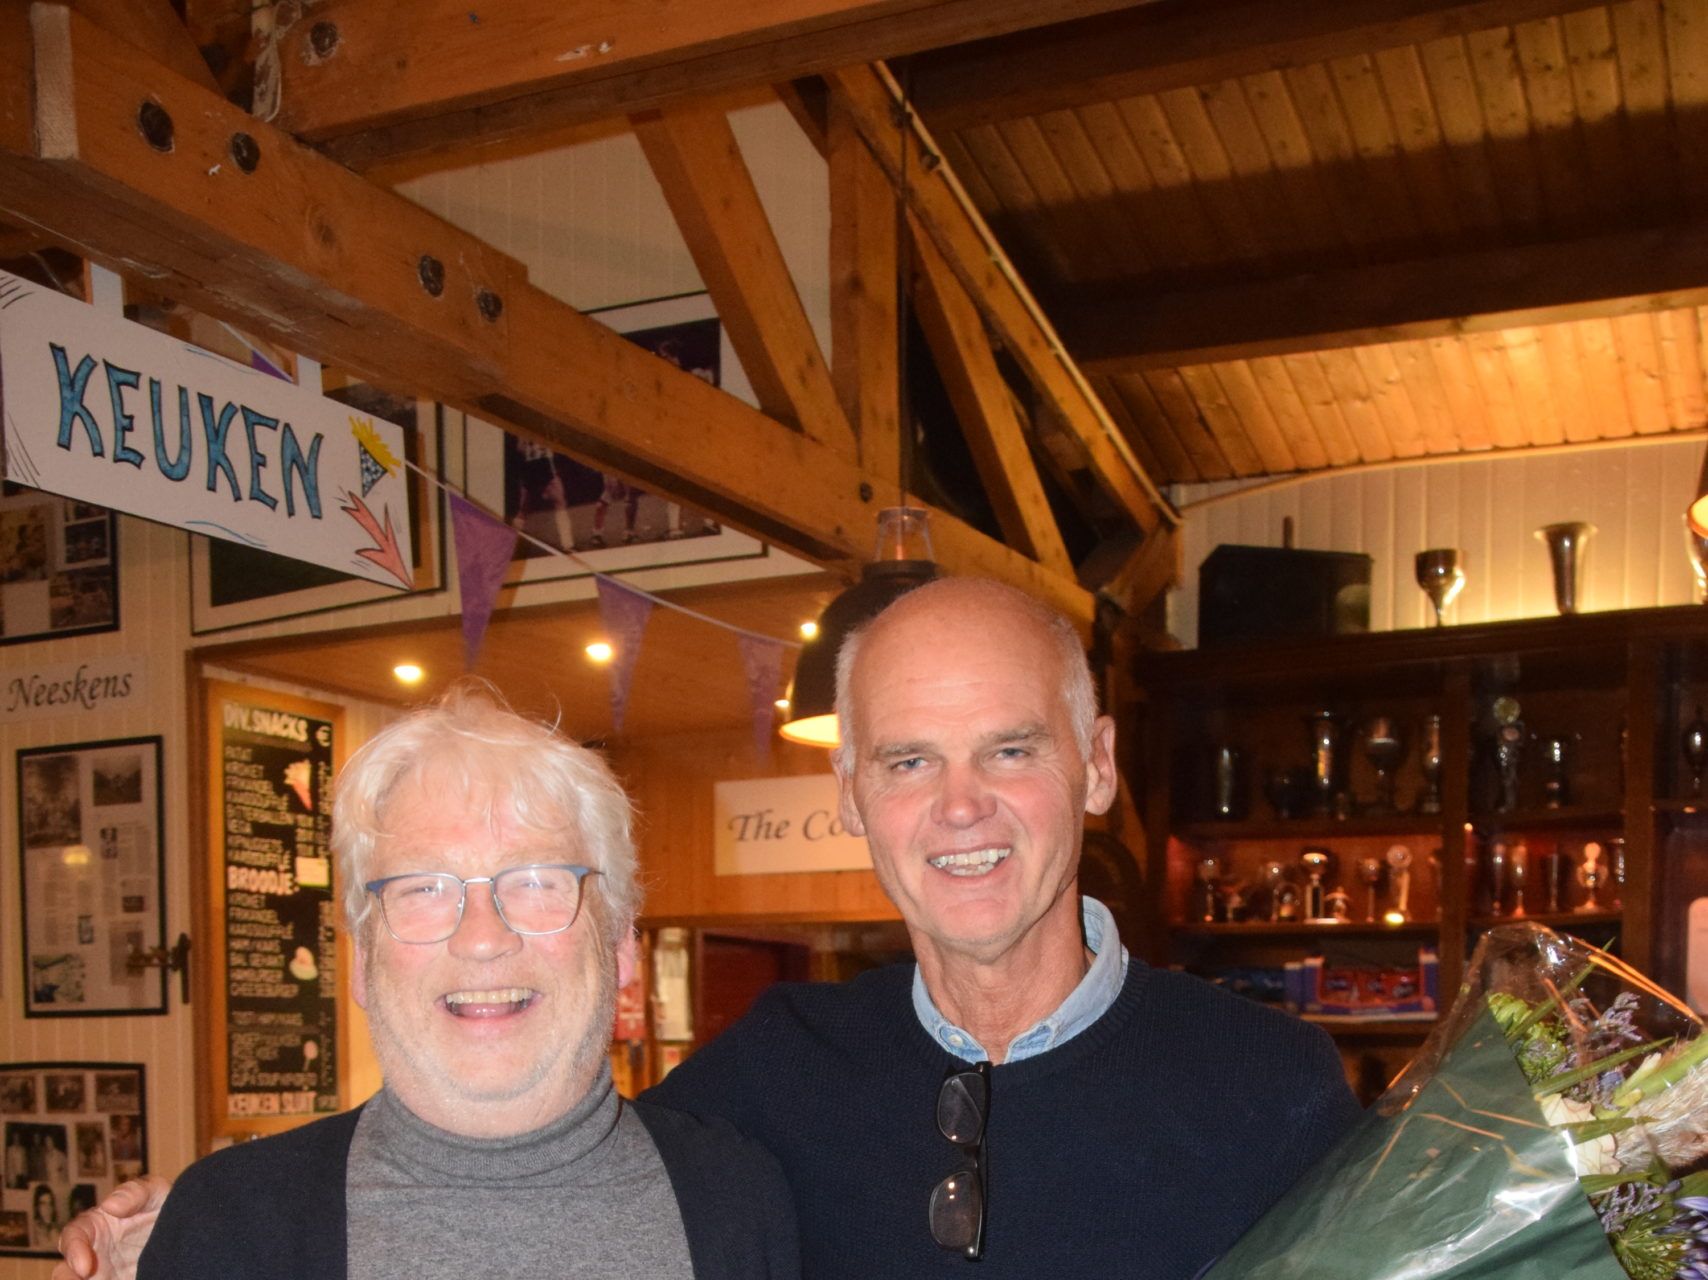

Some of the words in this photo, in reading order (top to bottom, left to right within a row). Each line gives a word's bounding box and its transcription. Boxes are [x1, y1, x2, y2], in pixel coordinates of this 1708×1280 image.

[48, 342, 325, 520] KEUKEN
[6, 664, 133, 712] Neeskens
[728, 808, 791, 842] The
